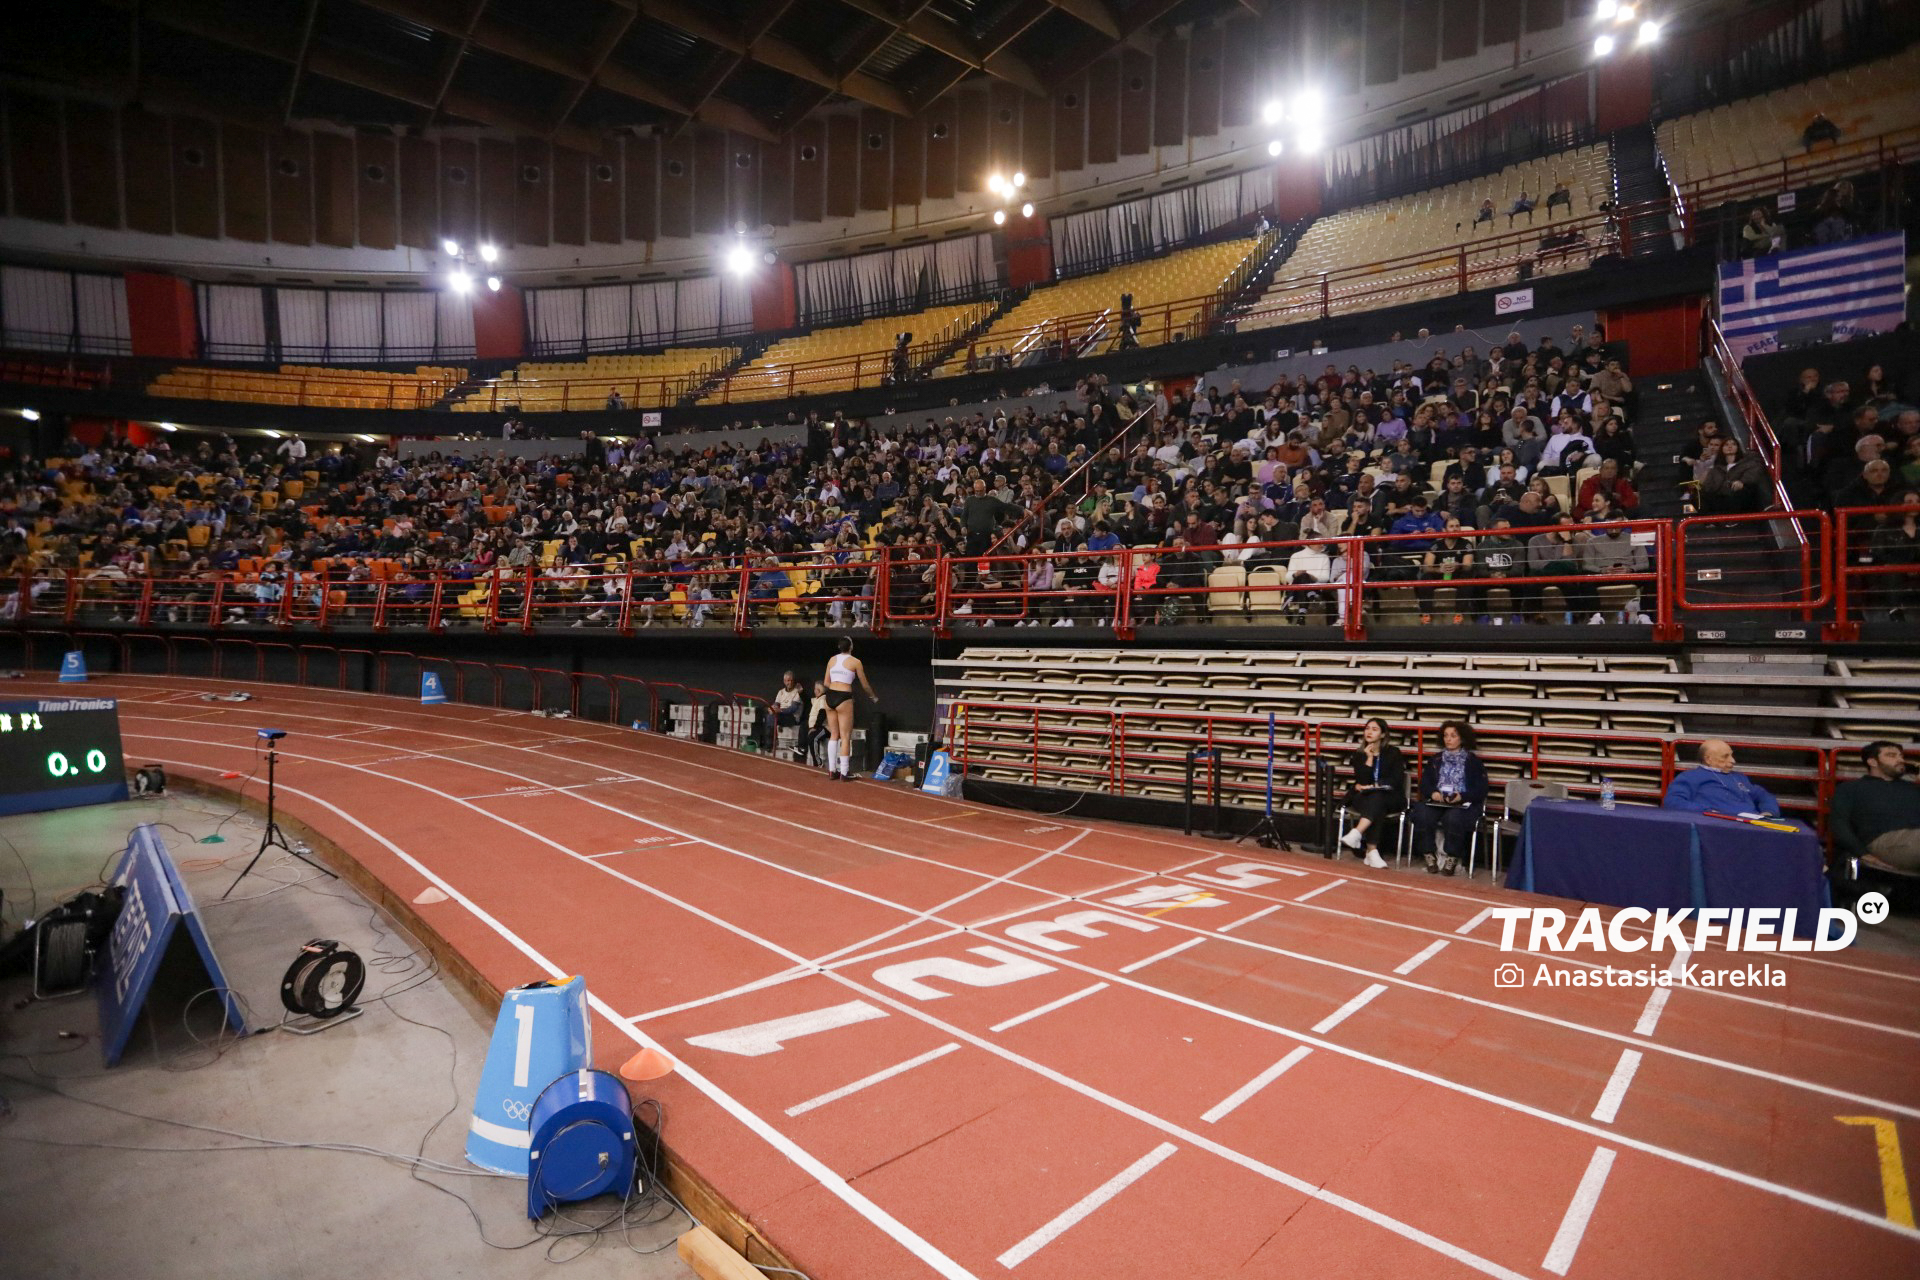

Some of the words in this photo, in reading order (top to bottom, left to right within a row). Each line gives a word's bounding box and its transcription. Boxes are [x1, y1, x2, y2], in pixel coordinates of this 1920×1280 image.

[67, 654, 79, 668] 5
[426, 677, 437, 689] 4
[38, 700, 114, 712] TimeTronics
[931, 754, 945, 776] 2
[1185, 862, 1311, 889] 5
[1004, 910, 1160, 951] 3
[872, 946, 1059, 1001] 2
[684, 1000, 891, 1057] 1
[513, 1004, 535, 1088] 1
